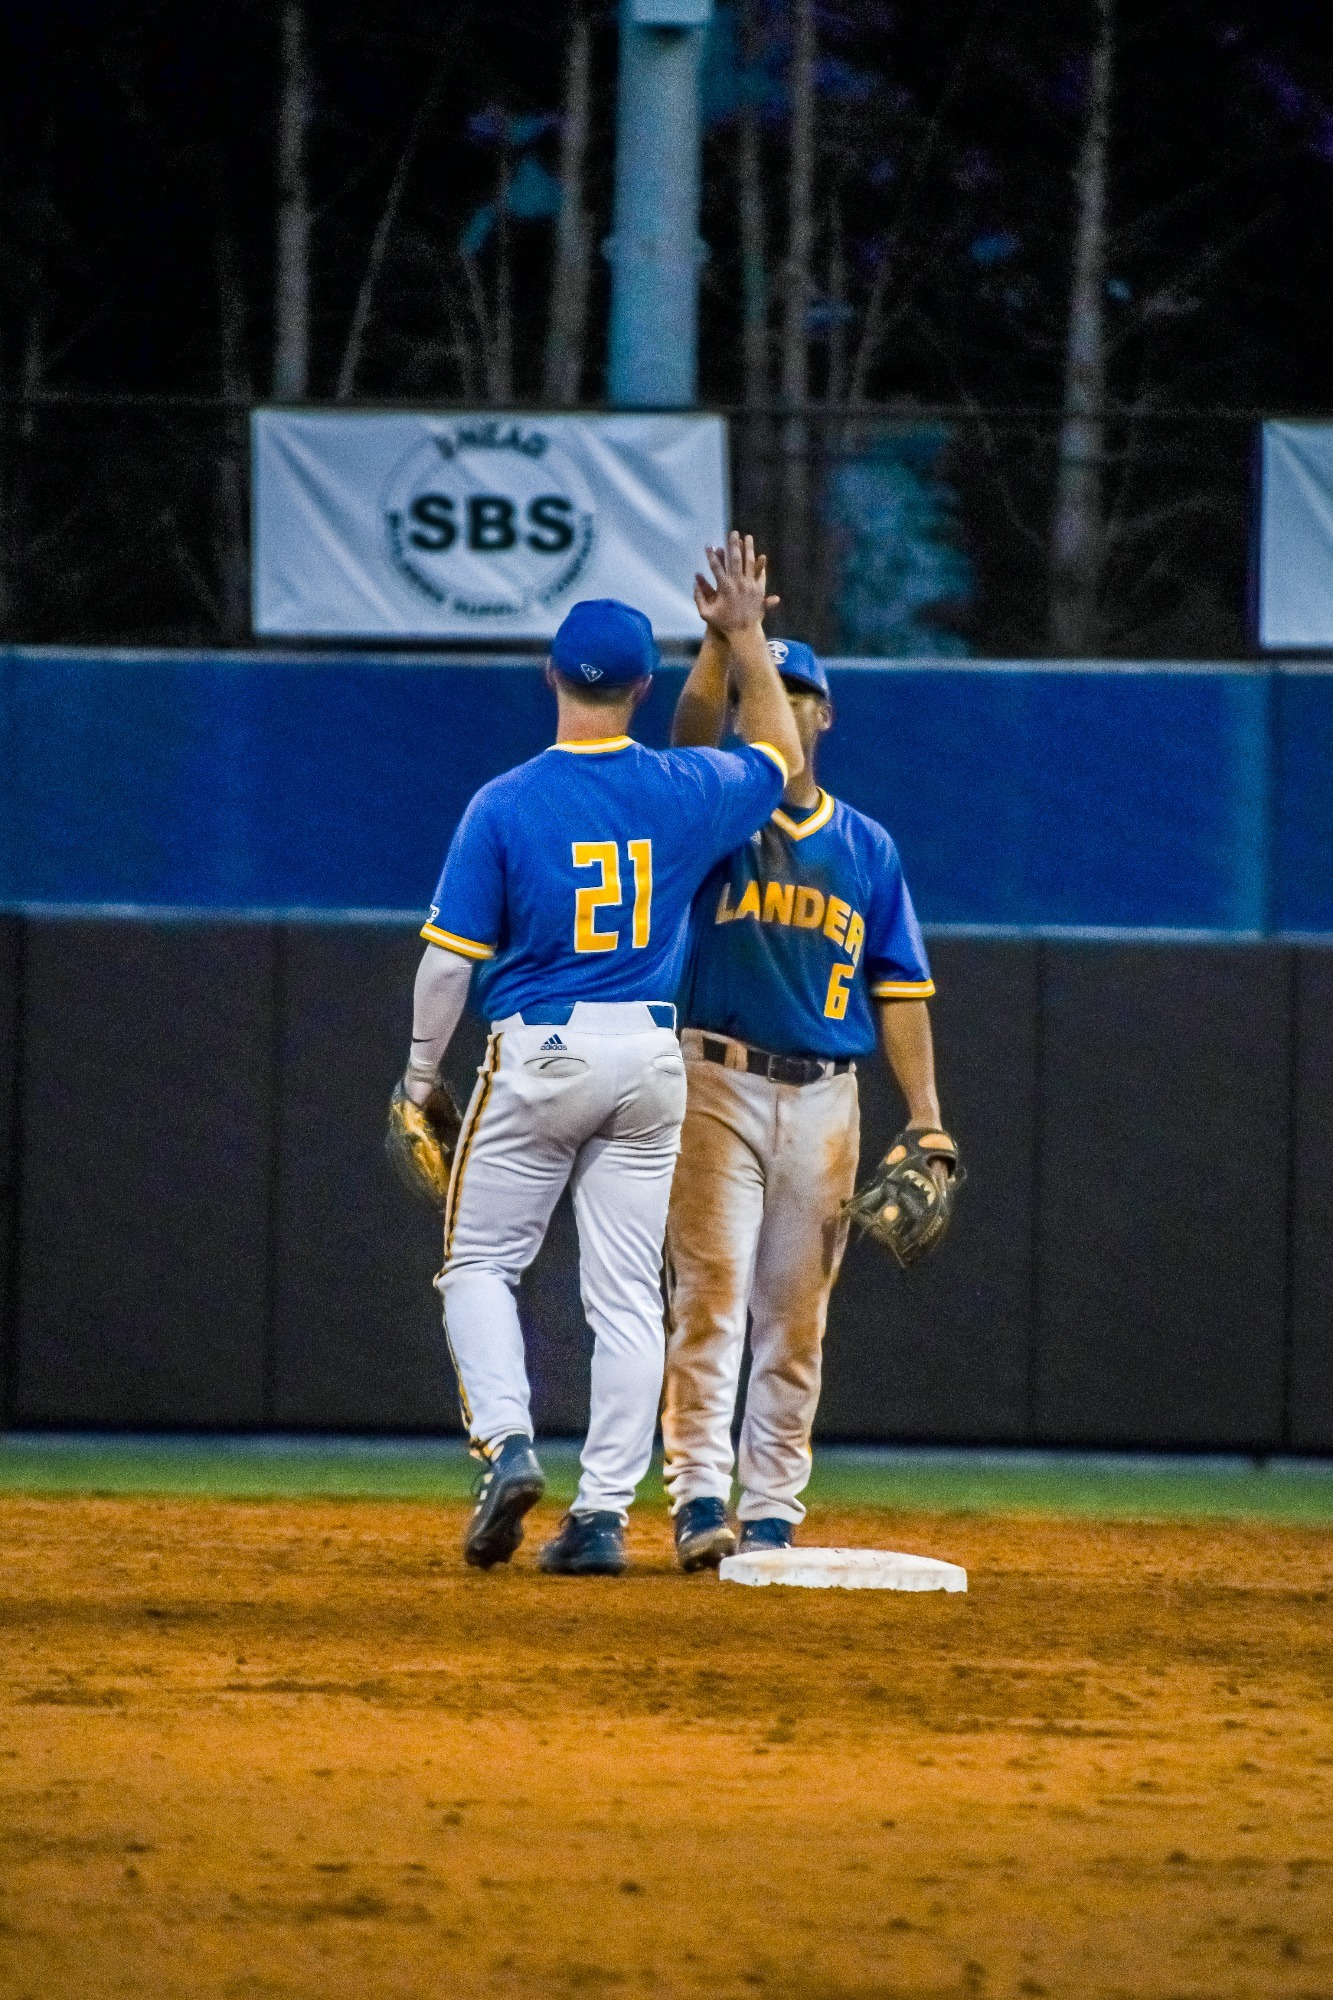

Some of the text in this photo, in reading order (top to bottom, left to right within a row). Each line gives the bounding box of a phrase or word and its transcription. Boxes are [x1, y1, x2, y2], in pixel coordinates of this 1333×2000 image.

[408, 493, 575, 555] SBS
[571, 838, 652, 953] 21
[714, 880, 866, 968] LANDER
[824, 963, 855, 1020] 6
[540, 1043, 568, 1051] adidas
